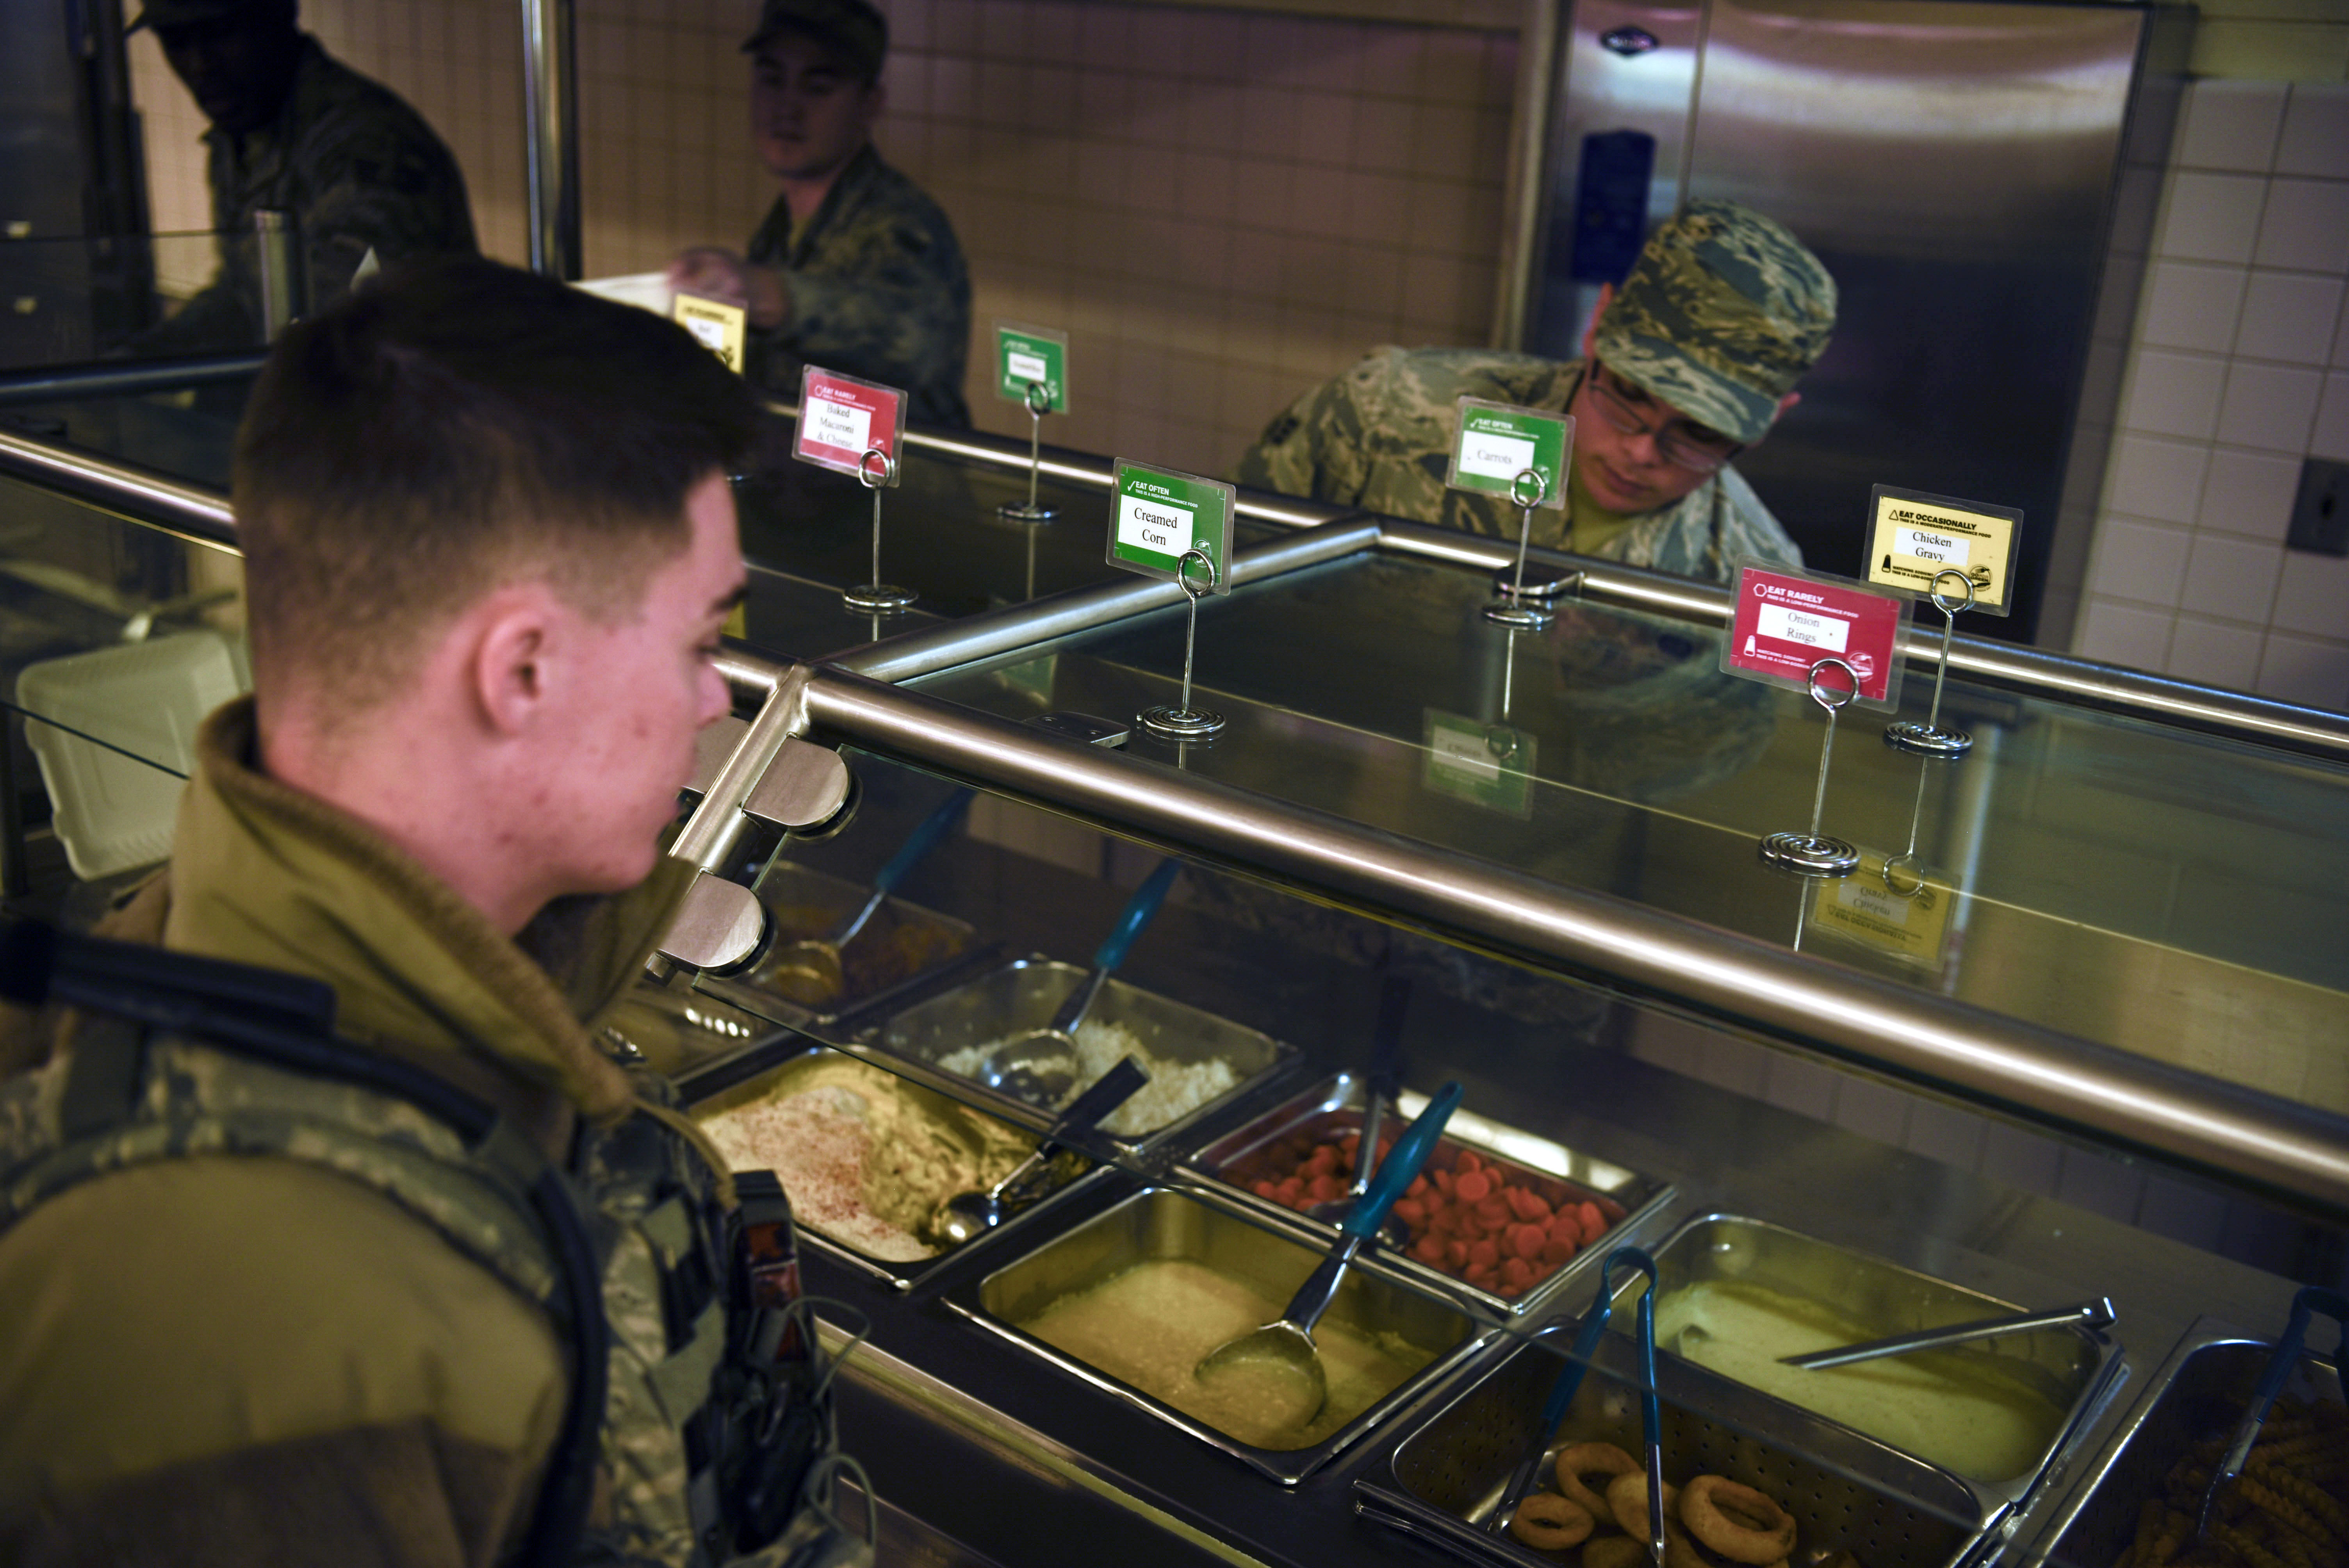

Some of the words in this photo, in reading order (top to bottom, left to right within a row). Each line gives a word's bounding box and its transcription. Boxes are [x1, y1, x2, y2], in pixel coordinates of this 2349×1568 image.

[834, 389, 856, 400] RARELY
[827, 404, 850, 418] Baked
[820, 416, 854, 434] Macaroni
[1492, 420, 1513, 429] OFTEN
[818, 431, 824, 441] &
[827, 434, 853, 448] Cheese
[1477, 449, 1513, 464] Carrots
[1135, 481, 1148, 490] EAT
[1149, 484, 1169, 495] OFTEN
[1151, 493, 1187, 506] HIGH-PERFORMANCE
[1134, 507, 1177, 529] Creamed
[1916, 513, 1977, 530] OCCASIONALLY
[1142, 529, 1166, 545] Corn
[1920, 522, 1977, 536] MODERATE-PERFORMANCE
[1913, 531, 1952, 547] Chicken
[1916, 547, 1944, 563] Gravy
[1768, 586, 1786, 595] EAT
[1787, 590, 1824, 604] RARELY
[1788, 612, 1820, 627] Onion
[1787, 627, 1816, 643] Rings
